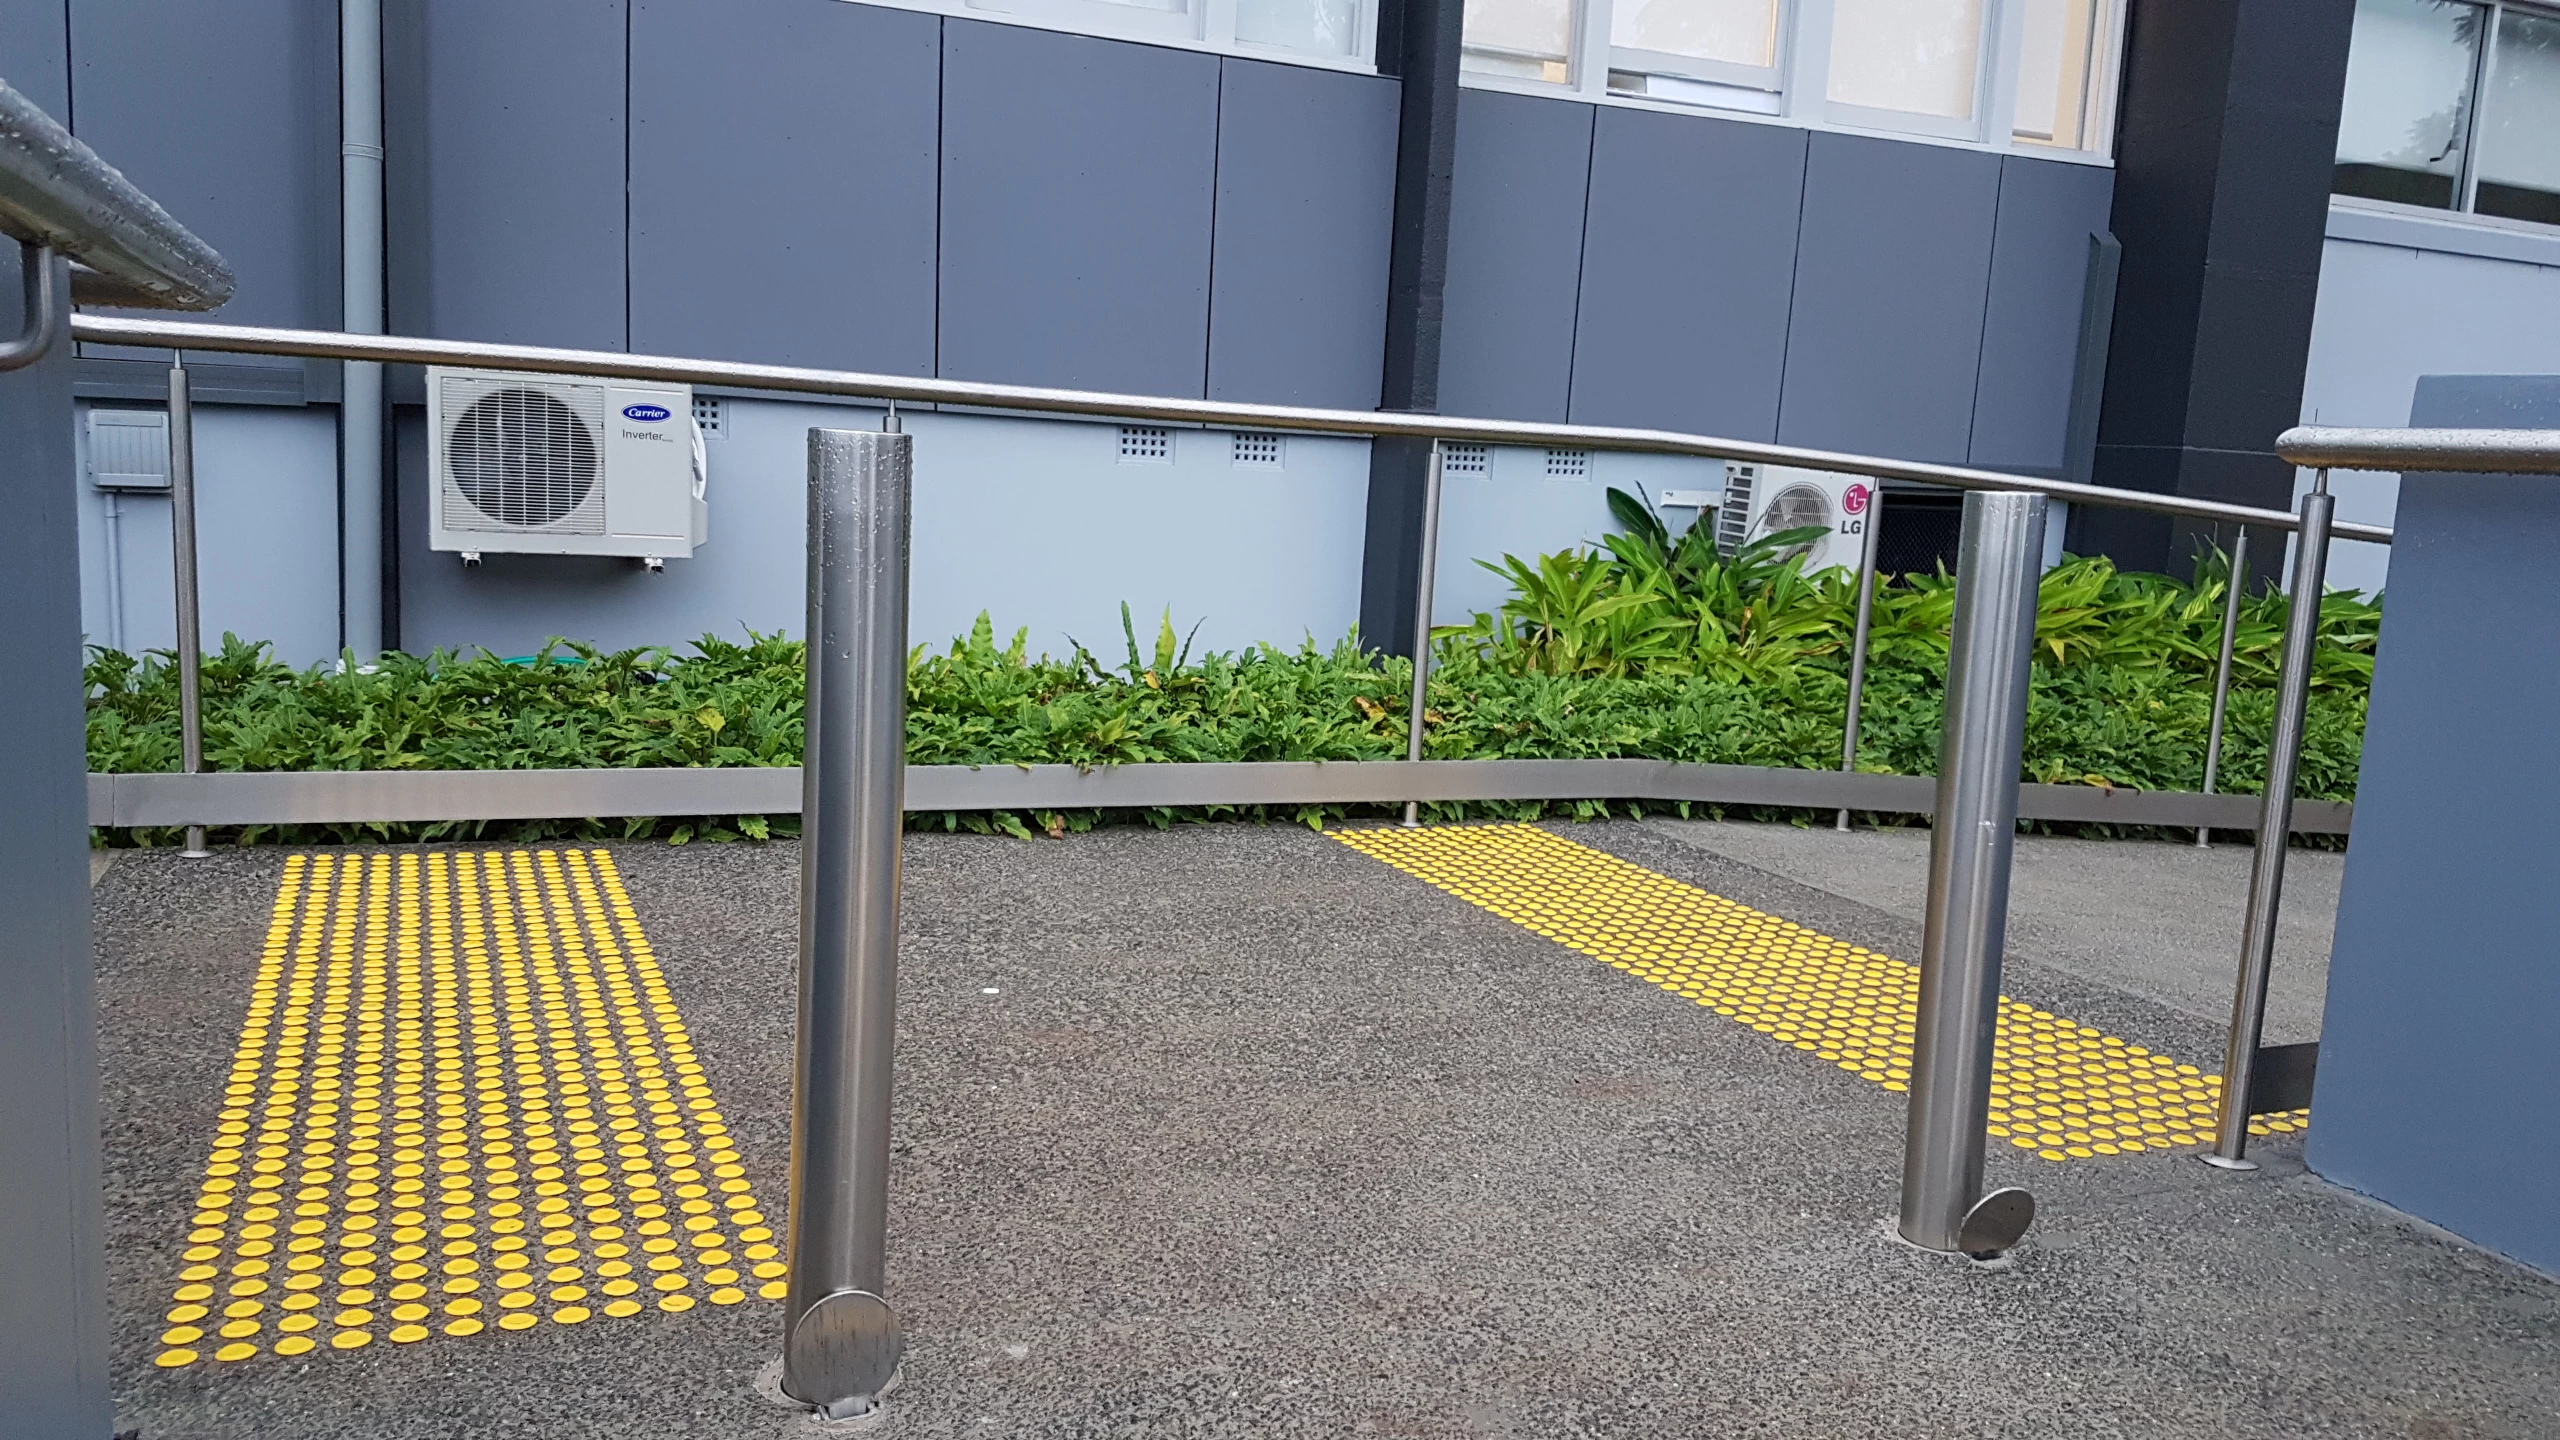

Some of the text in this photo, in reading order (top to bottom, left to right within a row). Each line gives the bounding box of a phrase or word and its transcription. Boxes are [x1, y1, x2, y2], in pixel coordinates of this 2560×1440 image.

[628, 408, 666, 418] Carrier
[622, 429, 664, 441] Inverter
[1841, 520, 1862, 535] LG
